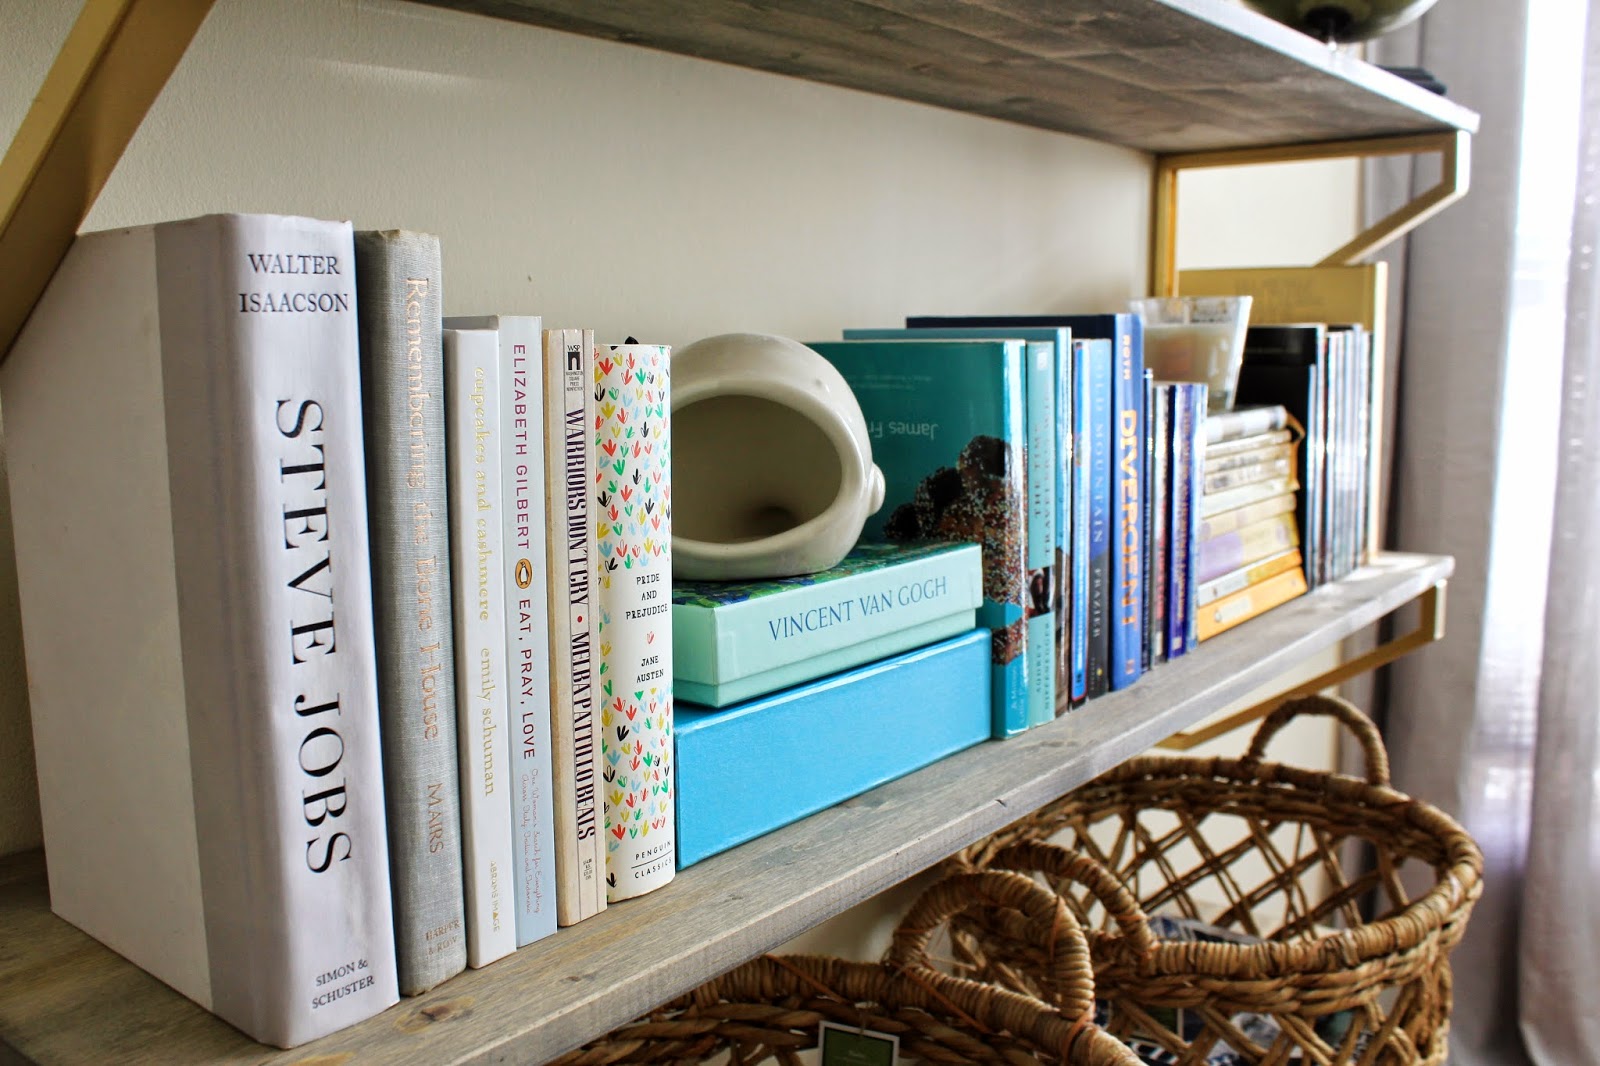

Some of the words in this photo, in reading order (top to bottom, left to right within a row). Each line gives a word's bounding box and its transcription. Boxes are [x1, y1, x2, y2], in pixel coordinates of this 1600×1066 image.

[248, 253, 341, 276] WALTER
[239, 292, 350, 314] ISAACSON
[404, 276, 436, 490] Remembering
[513, 344, 528, 456] ELIZABETH
[470, 366, 493, 466] cupcakes
[867, 420, 883, 439] Fr
[888, 421, 939, 441] James
[566, 407, 587, 511] WARRIORS
[1093, 422, 1105, 544] MOUNTAIN
[475, 470, 492, 512] and
[515, 464, 530, 550] GILBERT
[275, 397, 336, 666] STEVE
[411, 500, 435, 547] the
[568, 514, 589, 567] DON'T
[1120, 409, 1139, 631] DIVERGENT
[415, 554, 439, 633] Bone
[476, 518, 494, 622] cashmere
[569, 569, 590, 606] CRY
[636, 573, 661, 587] PRIDE
[641, 590, 657, 601] AND
[519, 599, 532, 641] EAT,
[625, 603, 669, 620] PREJUDICE
[768, 600, 854, 642] VINCENT
[859, 589, 893, 617] VAN
[897, 575, 948, 607] GOGH
[1092, 567, 1103, 638] FRAZIER
[479, 647, 498, 702] emily
[520, 649, 535, 706] PRAY,
[571, 631, 592, 695] MELBA
[635, 669, 665, 684] AUSTEN
[640, 655, 659, 668] JANE
[418, 640, 442, 741] House
[481, 707, 498, 798] schuman
[522, 711, 536, 760] LOVE
[572, 697, 594, 783] PATTILLO
[294, 692, 353, 874] JOBS
[426, 781, 445, 855] MAIRS
[576, 784, 596, 841] BEALS
[634, 856, 672, 879] CLASSICS
[635, 840, 671, 861] PENGUIN
[425, 917, 461, 941] HARPER
[311, 974, 375, 1009] SCHUSTER
[315, 965, 355, 988] SIMON
[357, 959, 369, 973] &
